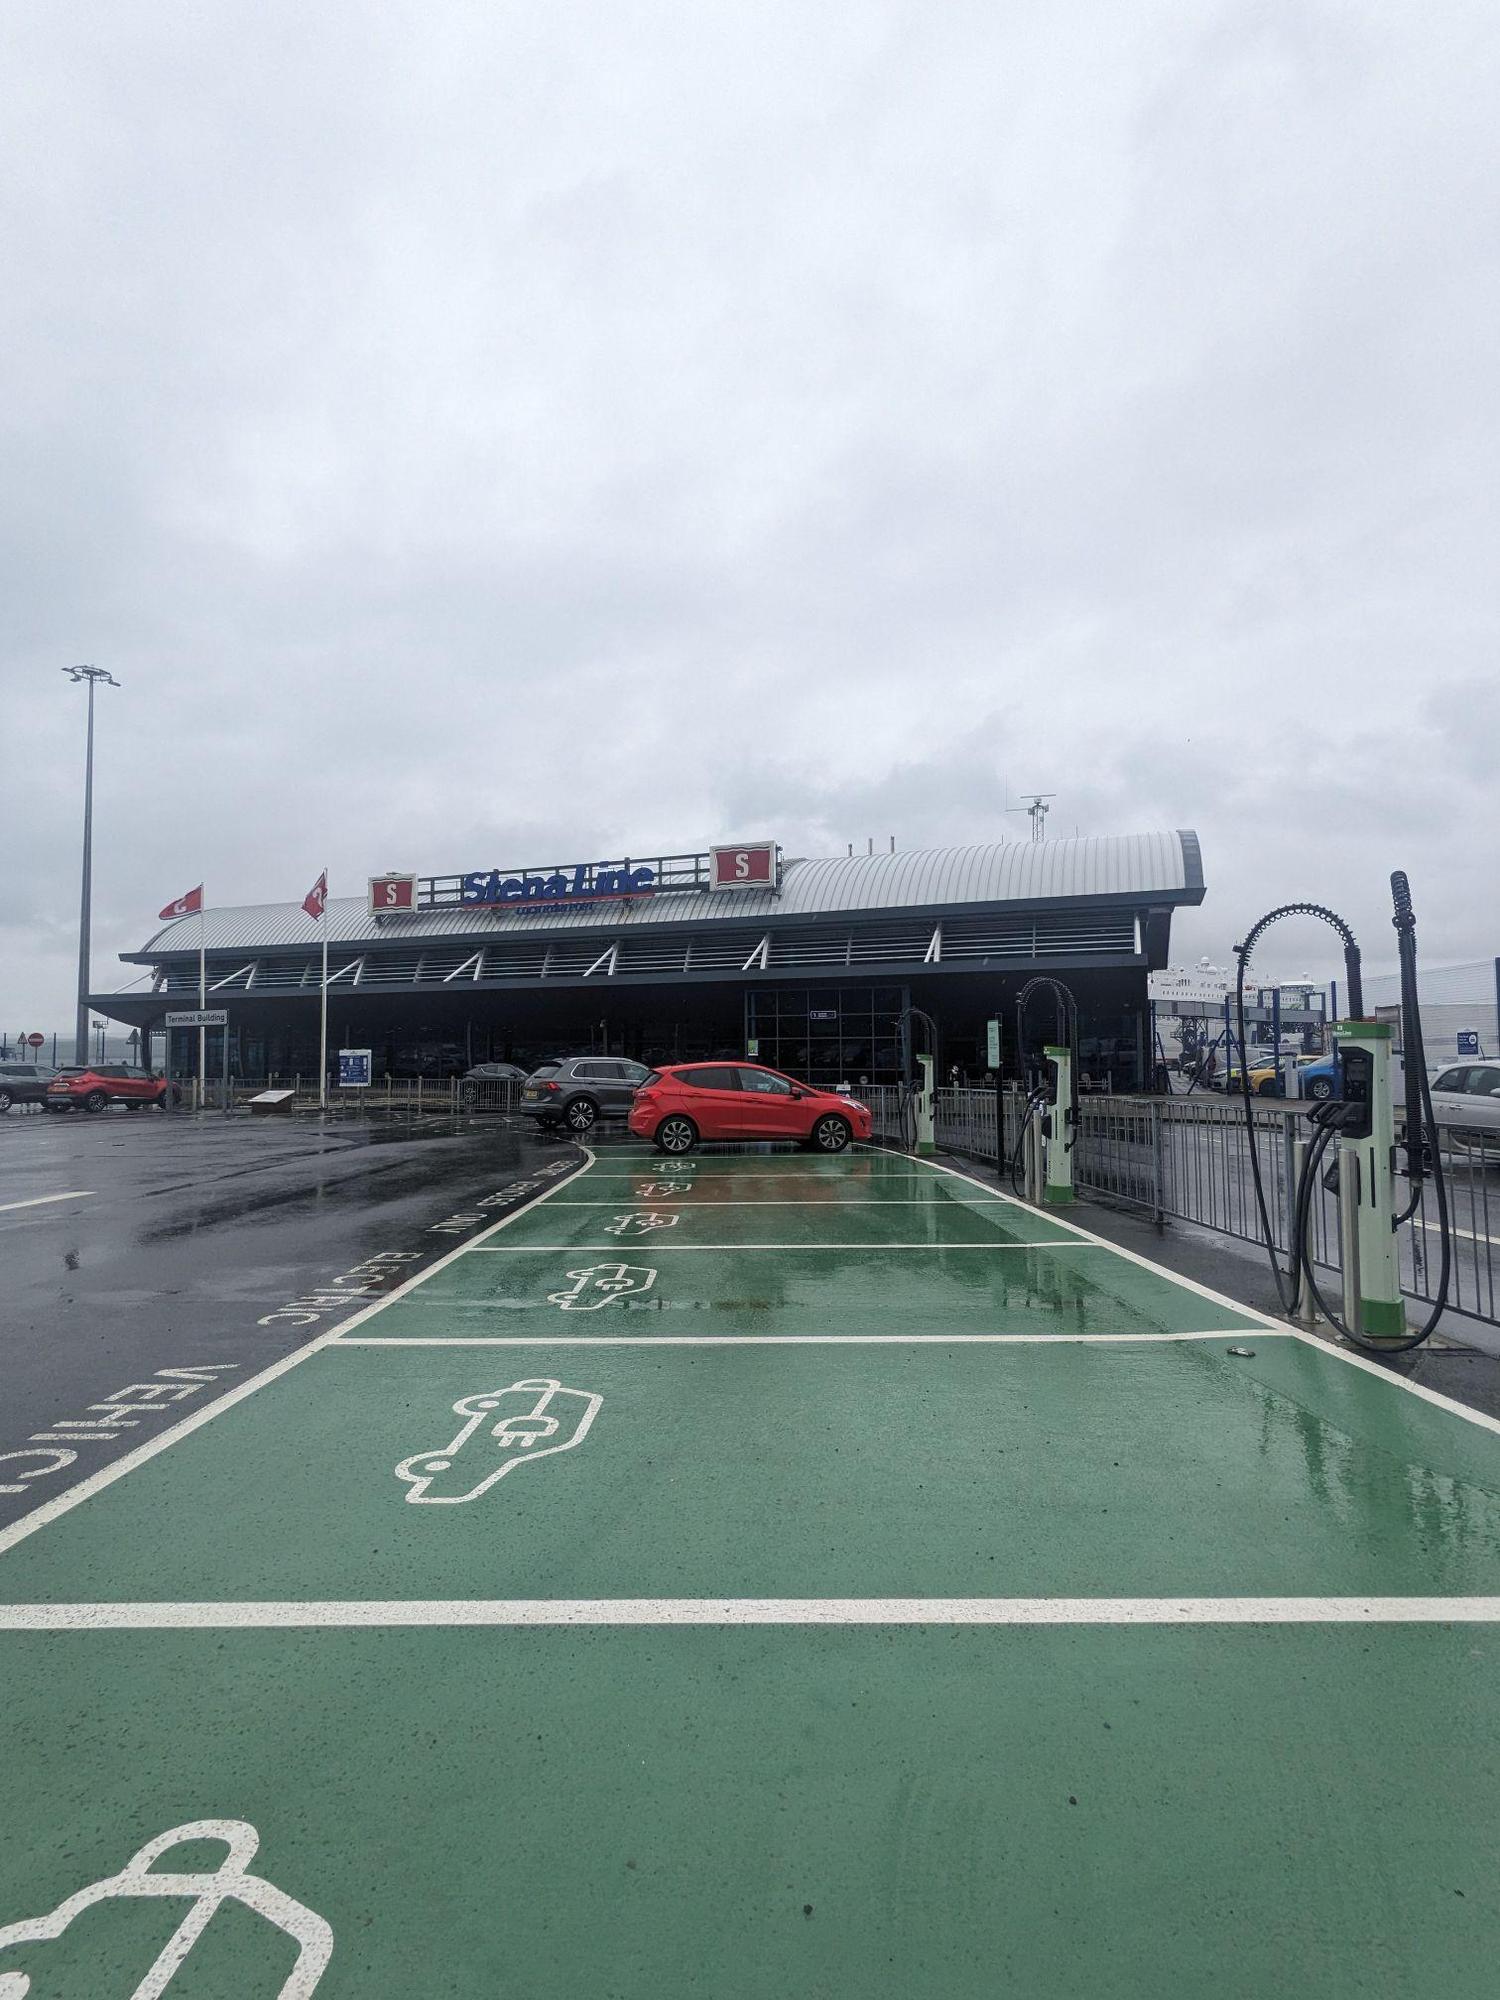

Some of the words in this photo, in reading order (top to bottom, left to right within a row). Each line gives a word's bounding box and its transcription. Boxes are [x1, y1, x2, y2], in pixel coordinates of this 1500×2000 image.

[735, 853, 749, 878] S
[386, 883, 397, 905] S
[167, 1014, 196, 1024] Terminal
[197, 1012, 225, 1022] Building
[425, 1213, 488, 1234] ONLY
[256, 1251, 425, 1326] ELECTRIC
